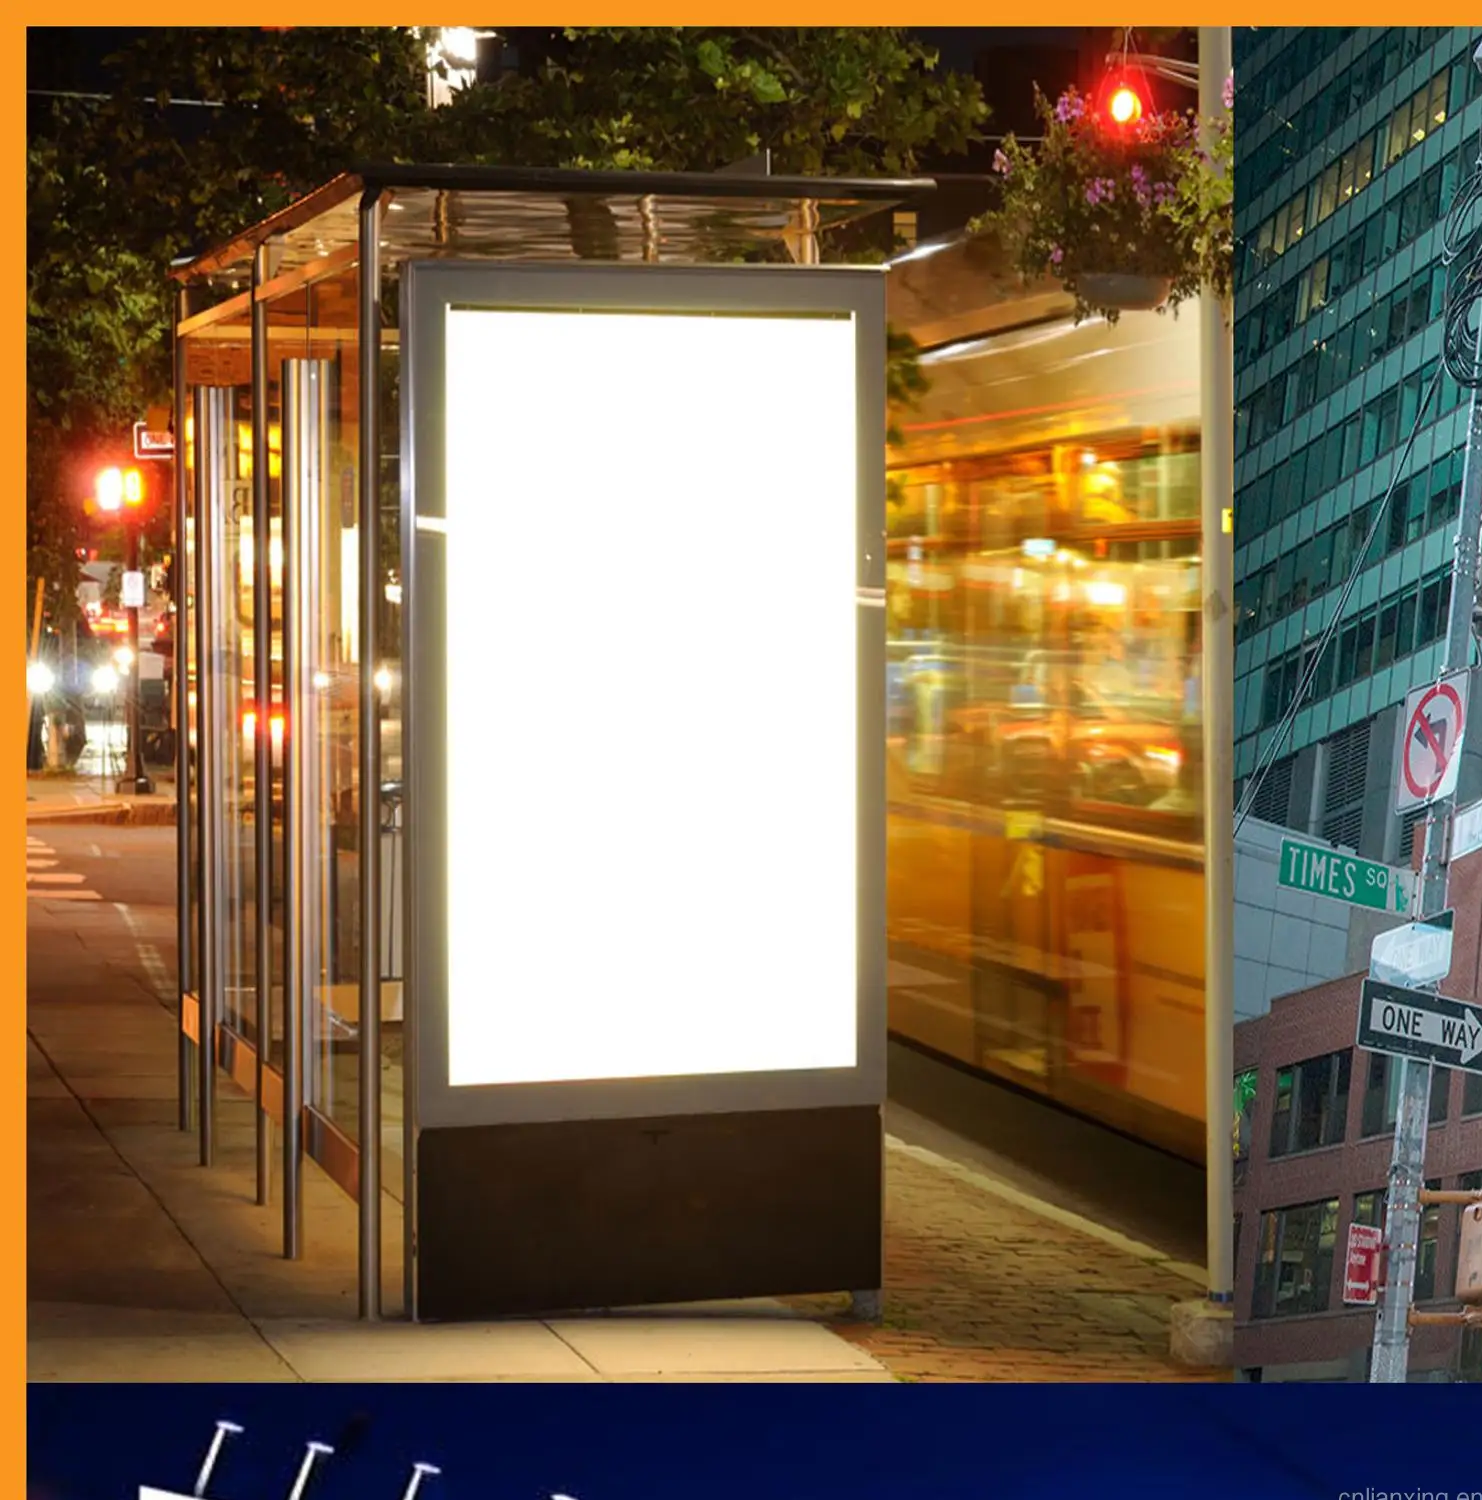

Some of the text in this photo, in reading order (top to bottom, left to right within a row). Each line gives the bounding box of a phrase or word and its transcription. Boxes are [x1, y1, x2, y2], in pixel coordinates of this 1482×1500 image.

[1287, 846, 1387, 899] TIMES SQ
[1382, 1004, 1481, 1050] ONE WAY
